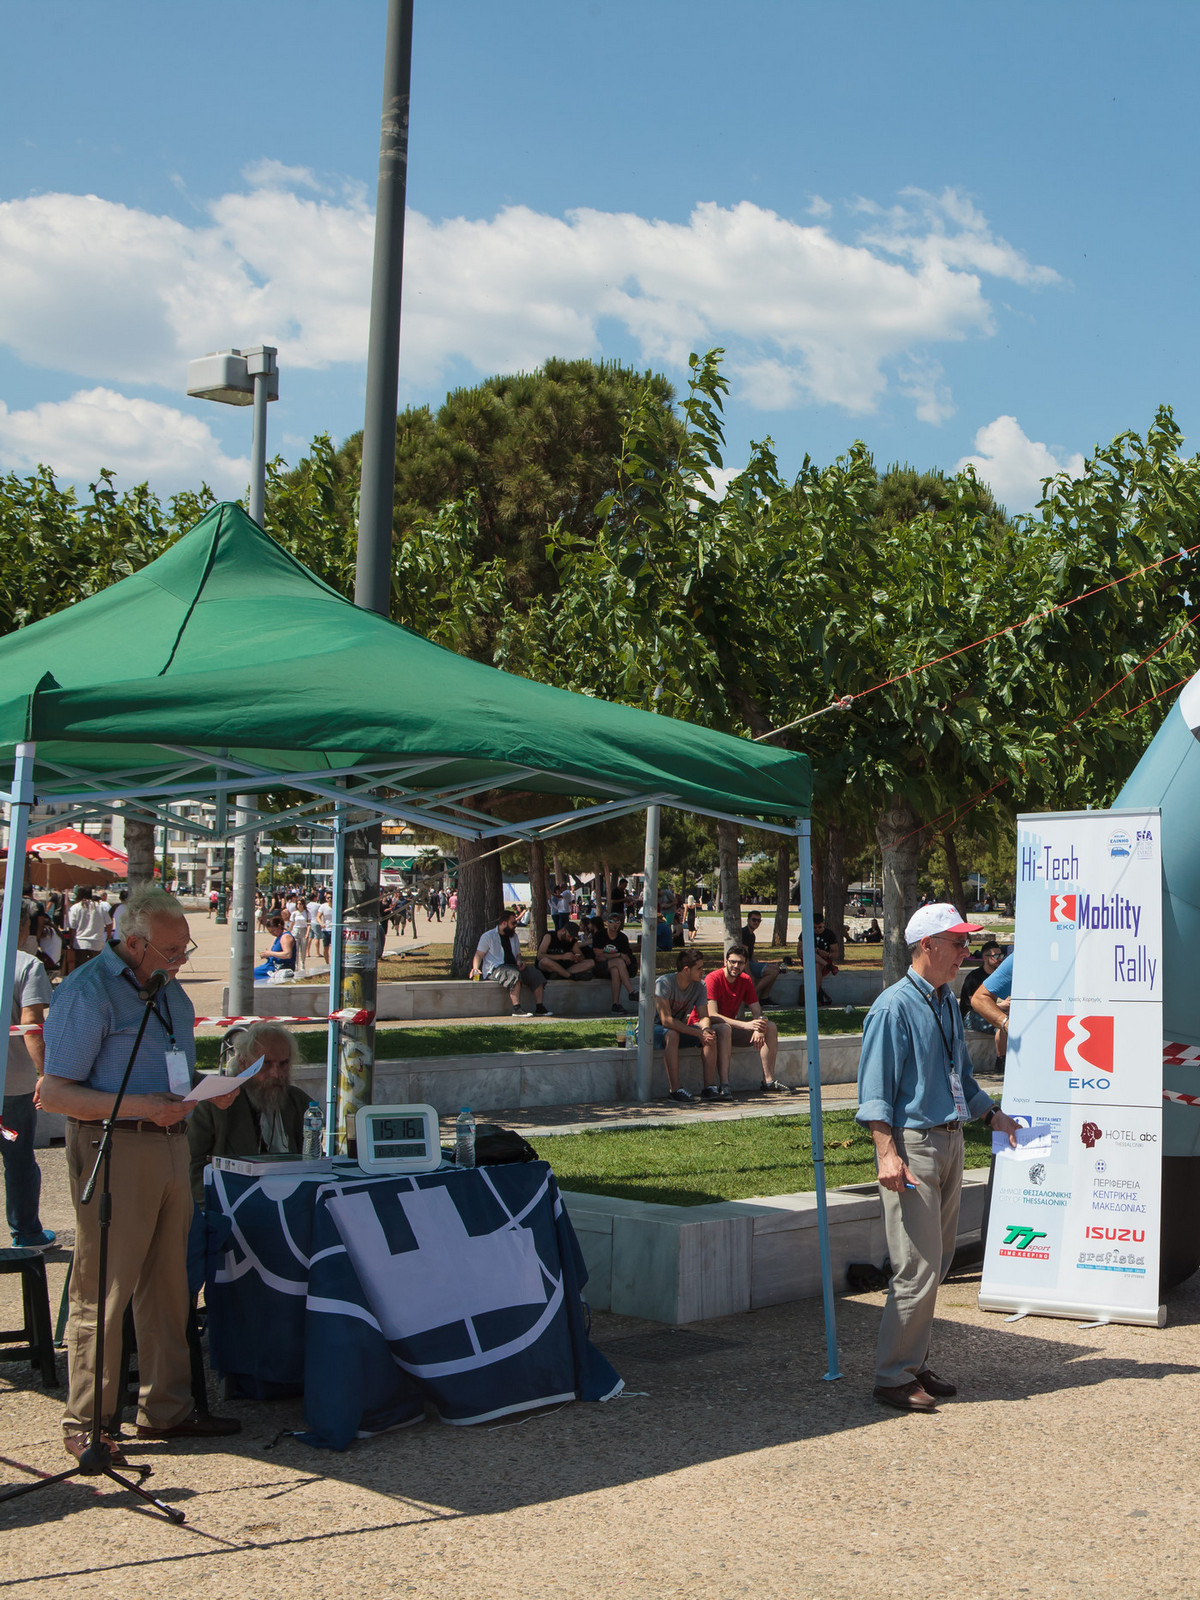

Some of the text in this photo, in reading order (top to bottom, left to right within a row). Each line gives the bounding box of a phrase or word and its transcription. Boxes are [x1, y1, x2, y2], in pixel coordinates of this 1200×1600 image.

[1021, 844, 1079, 882] Hi-Tech
[1078, 893, 1141, 938] Mobility
[1056, 923, 1076, 931] EKO
[1114, 944, 1157, 990] Rally
[1068, 1078, 1111, 1089] EKO
[1105, 1129, 1157, 1142] HOTEL abc
[1093, 1178, 1141, 1189] ΠΕΡΙΦΕΡΕΙΑ
[1022, 1188, 1072, 1199] ΘΕΣΣΑΛΟΝΙΚΗΣ
[1092, 1190, 1138, 1201] ΚΕΝΤΡΙΚΗΣ
[1022, 1197, 1068, 1206] THESSALONIKI
[1092, 1202, 1147, 1213] ΜΑΚΕΔΟΝΙΑΣ
[1085, 1226, 1146, 1243] ISUZU
[1027, 1243, 1051, 1251] sport
[1017, 1251, 1049, 1259] KEEPING
[1078, 1249, 1145, 1266] grafista
